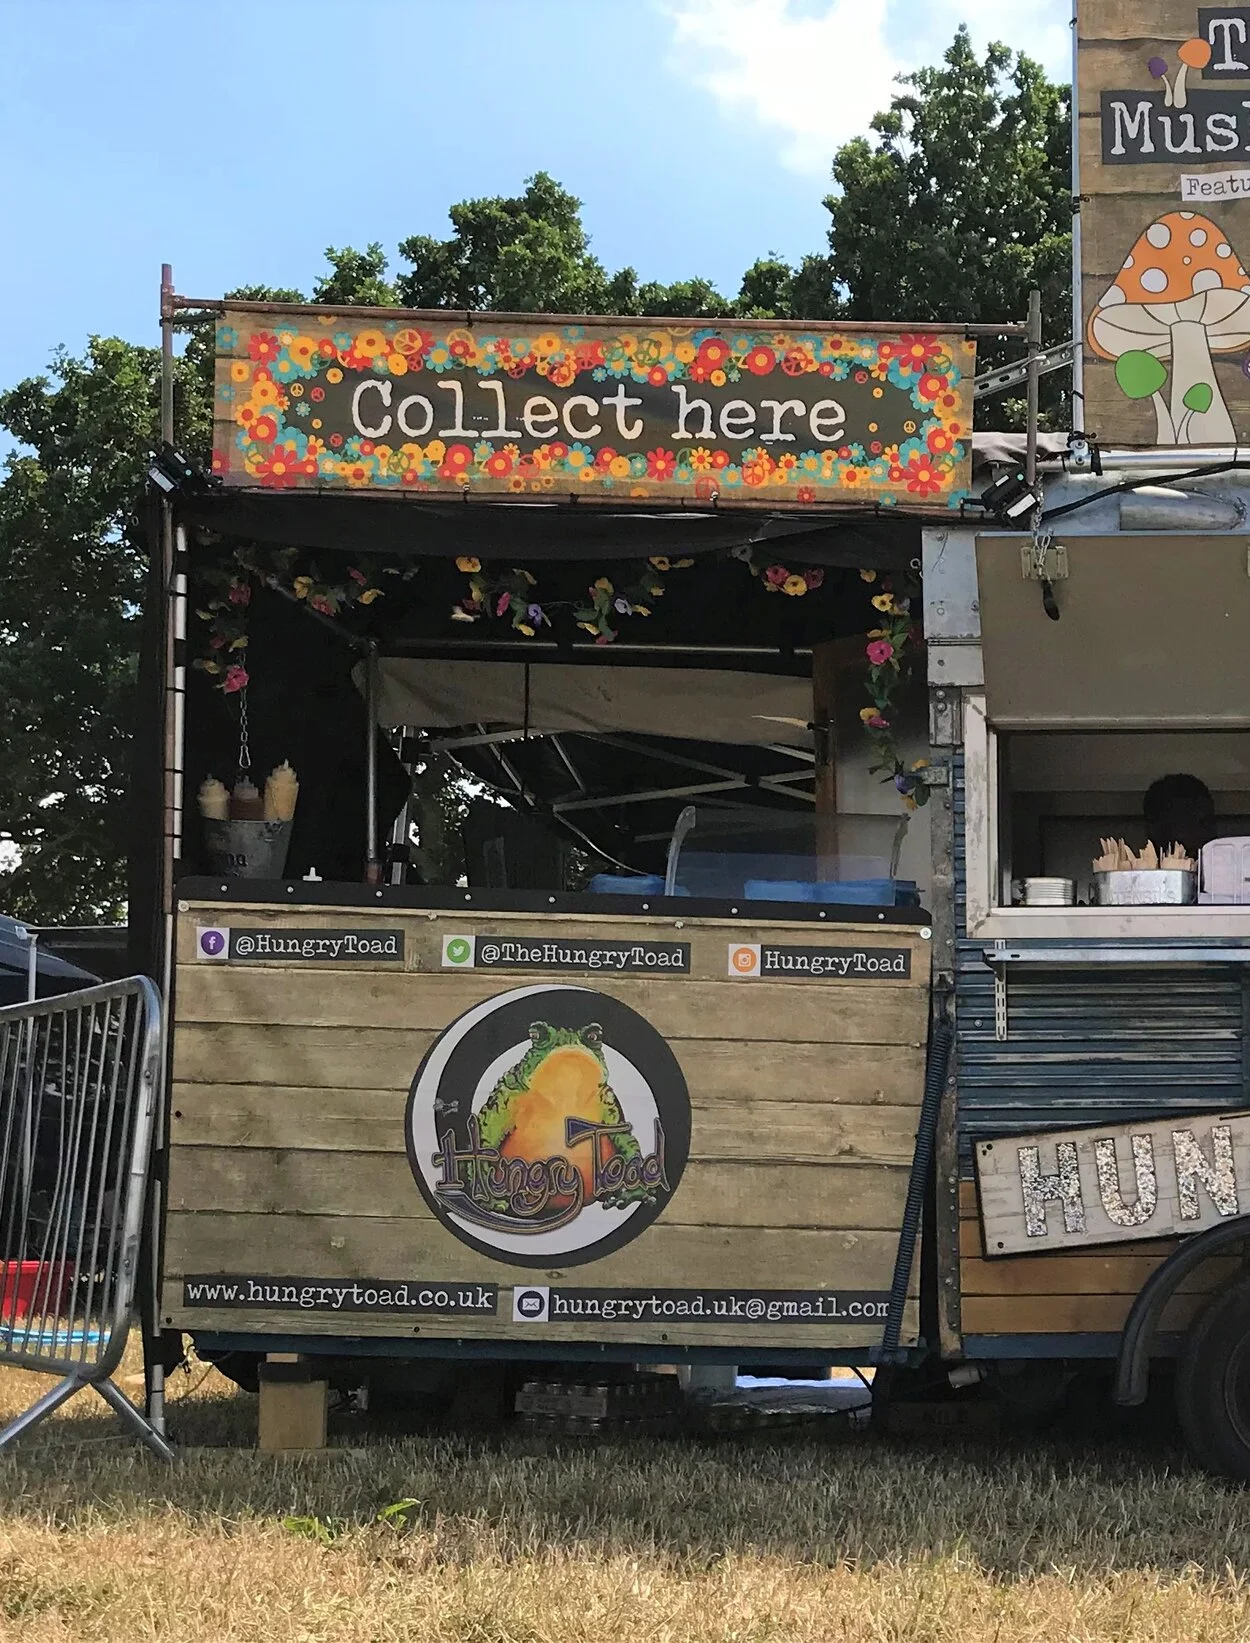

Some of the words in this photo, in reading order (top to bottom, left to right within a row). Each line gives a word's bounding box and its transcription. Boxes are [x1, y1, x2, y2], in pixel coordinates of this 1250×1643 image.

[350, 379, 645, 441] Collect
[669, 384, 848, 445] here
[235, 934, 398, 958] @HungryToad
[480, 943, 686, 968] @TheHungryToad
[764, 950, 906, 976] HungryToad
[187, 1280, 493, 1309] www.hungrytoad.co.uk
